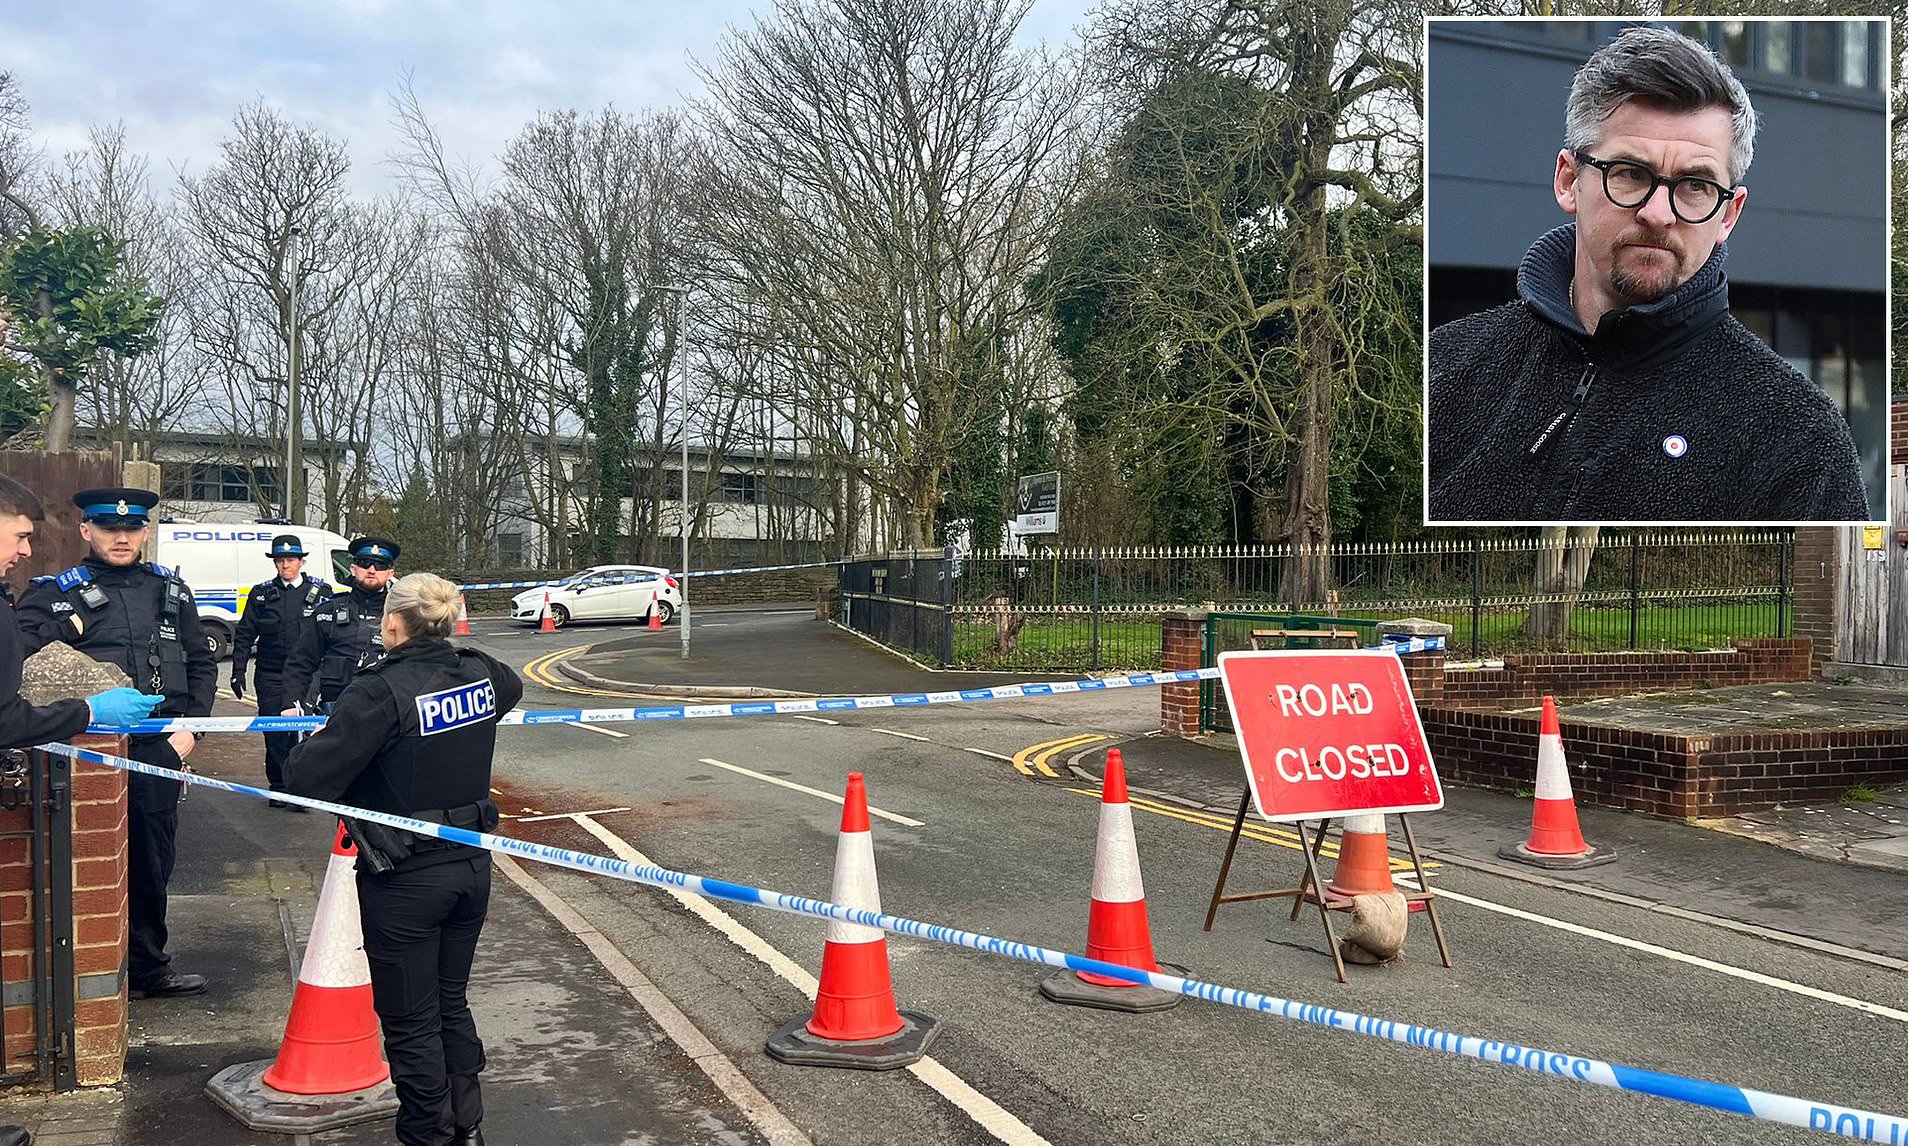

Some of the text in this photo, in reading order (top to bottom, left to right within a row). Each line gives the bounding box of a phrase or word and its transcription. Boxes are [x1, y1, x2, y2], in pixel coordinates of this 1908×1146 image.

[1529, 433, 1547, 454] GOOSE
[173, 532, 273, 541] POLICE
[423, 685, 495, 728] POLICE
[1275, 682, 1374, 718] ROAD
[1275, 743, 1410, 783] CLOSED
